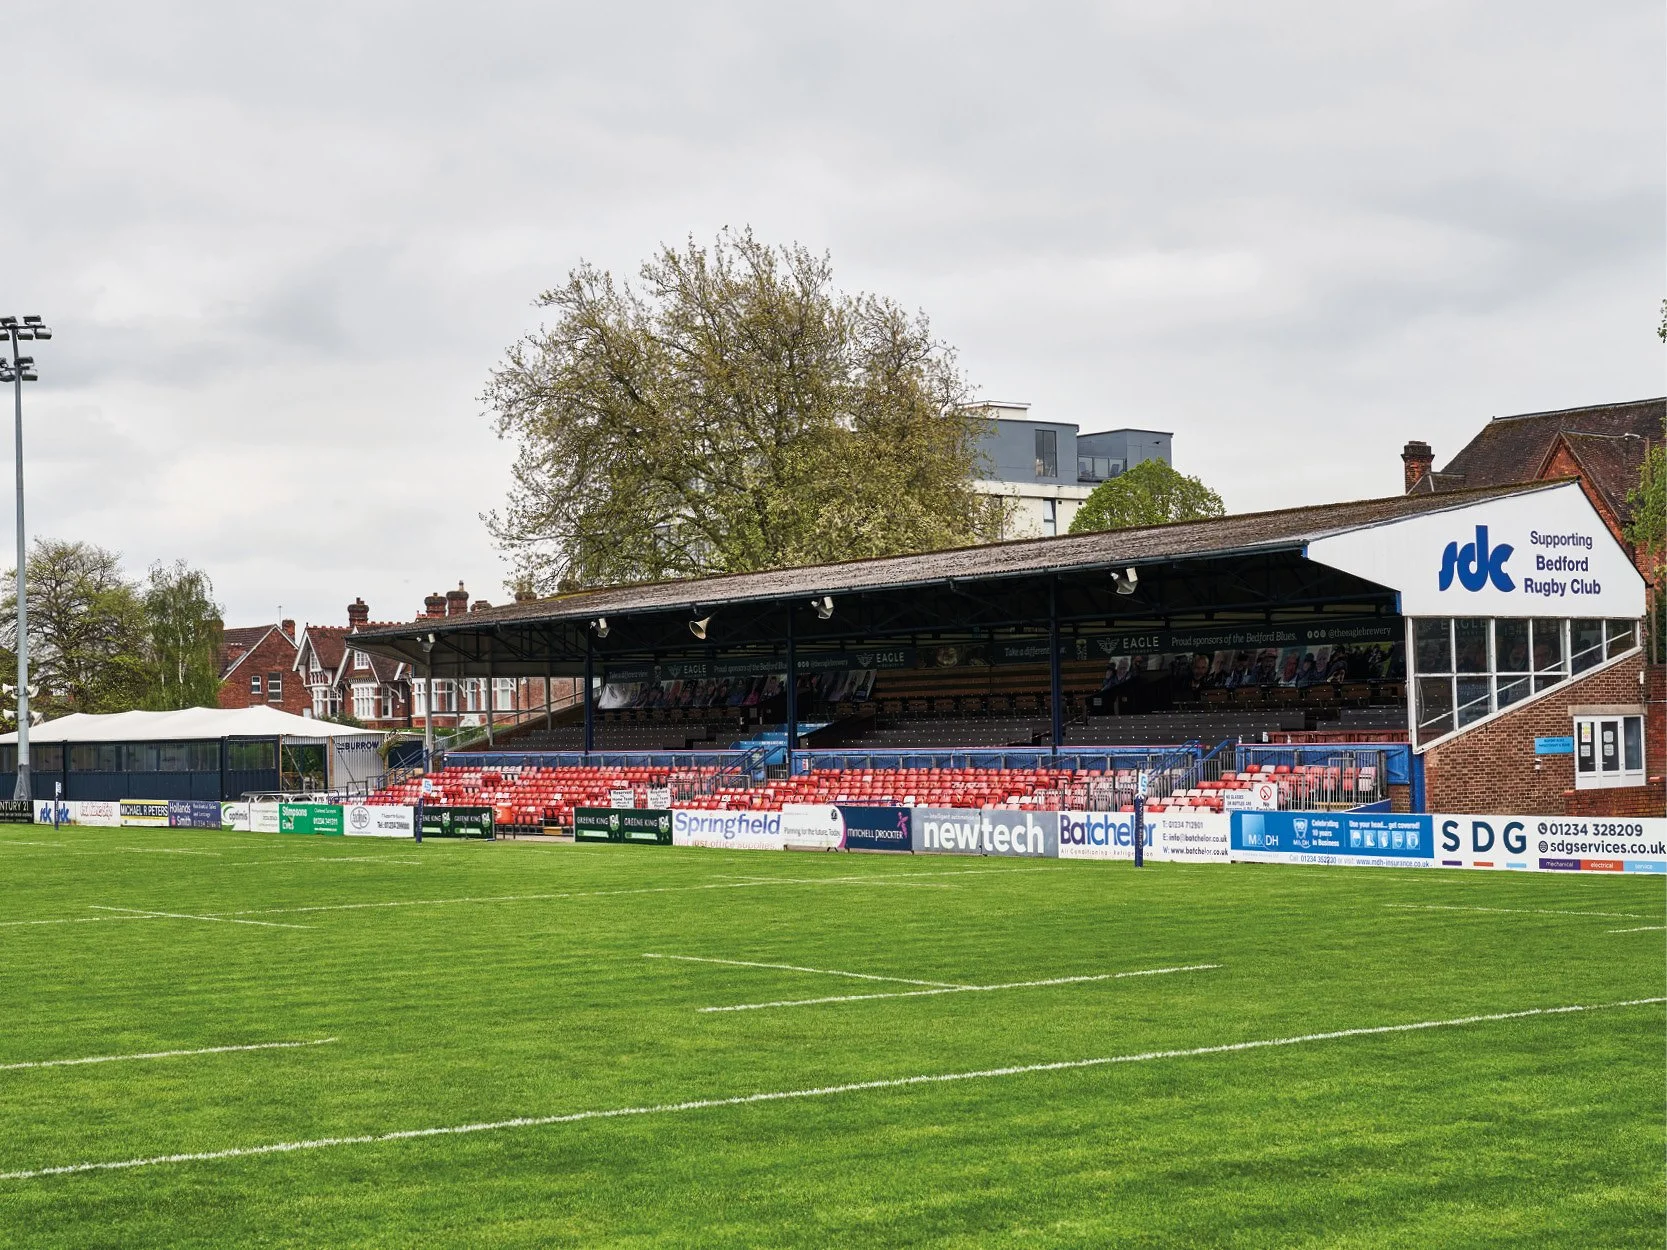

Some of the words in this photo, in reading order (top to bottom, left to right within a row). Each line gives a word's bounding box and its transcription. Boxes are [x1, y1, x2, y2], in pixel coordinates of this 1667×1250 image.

[1530, 530, 1593, 549] Supporting
[1536, 554, 1589, 572] Bedford
[1524, 578, 1567, 597] Rugby
[1570, 579, 1601, 595] Club
[1328, 626, 1391, 640] @theeaglebrewery
[1123, 636, 1160, 649] EAGLE
[1171, 636, 1192, 647] Proud
[1192, 635, 1223, 648] sponsors
[1223, 634, 1232, 646] of
[1232, 634, 1244, 644] the
[1246, 632, 1275, 644] Bedford
[876, 652, 905, 663] EAGLE
[683, 664, 707, 674] EAGLE
[345, 741, 379, 750] BURROW
[22, 800, 29, 811] 21
[120, 805, 142, 816] MICHAEL
[143, 805, 148, 816] R
[148, 805, 168, 817] PETERS
[169, 802, 191, 814] Hollands
[282, 806, 308, 817] Stimpsons
[176, 815, 192, 827] Smith
[282, 819, 295, 830] Eves
[470, 815, 481, 823] KING
[576, 816, 595, 825] GREENE
[596, 817, 609, 825] KING
[624, 817, 644, 826] GREENE
[644, 818, 658, 827] KING
[1162, 820, 1168, 828] T:
[1168, 820, 1184, 829] 01234
[1311, 819, 1339, 829] Celebrating
[674, 811, 782, 840] Springfield
[1349, 820, 1359, 828] Use
[1359, 821, 1371, 829] your
[1388, 821, 1397, 830] get
[1549, 823, 1589, 836] 01234
[1592, 823, 1643, 837] 328209
[923, 814, 1044, 854] newtech
[1162, 833, 1168, 841] E:
[1169, 833, 1228, 843] info@batchelor.co.uk
[1319, 830, 1333, 838] years
[1441, 820, 1527, 855] SDG
[1318, 839, 1340, 847] Business
[1550, 839, 1667, 855] sdgservices.co.uk
[1070, 848, 1108, 856] Conditioning
[1162, 845, 1170, 854] W:
[1170, 846, 1229, 856] www.batchelor.co.uk
[1300, 855, 1317, 863] 01234
[1356, 858, 1429, 868] www.mdh-insurance.co.uk
